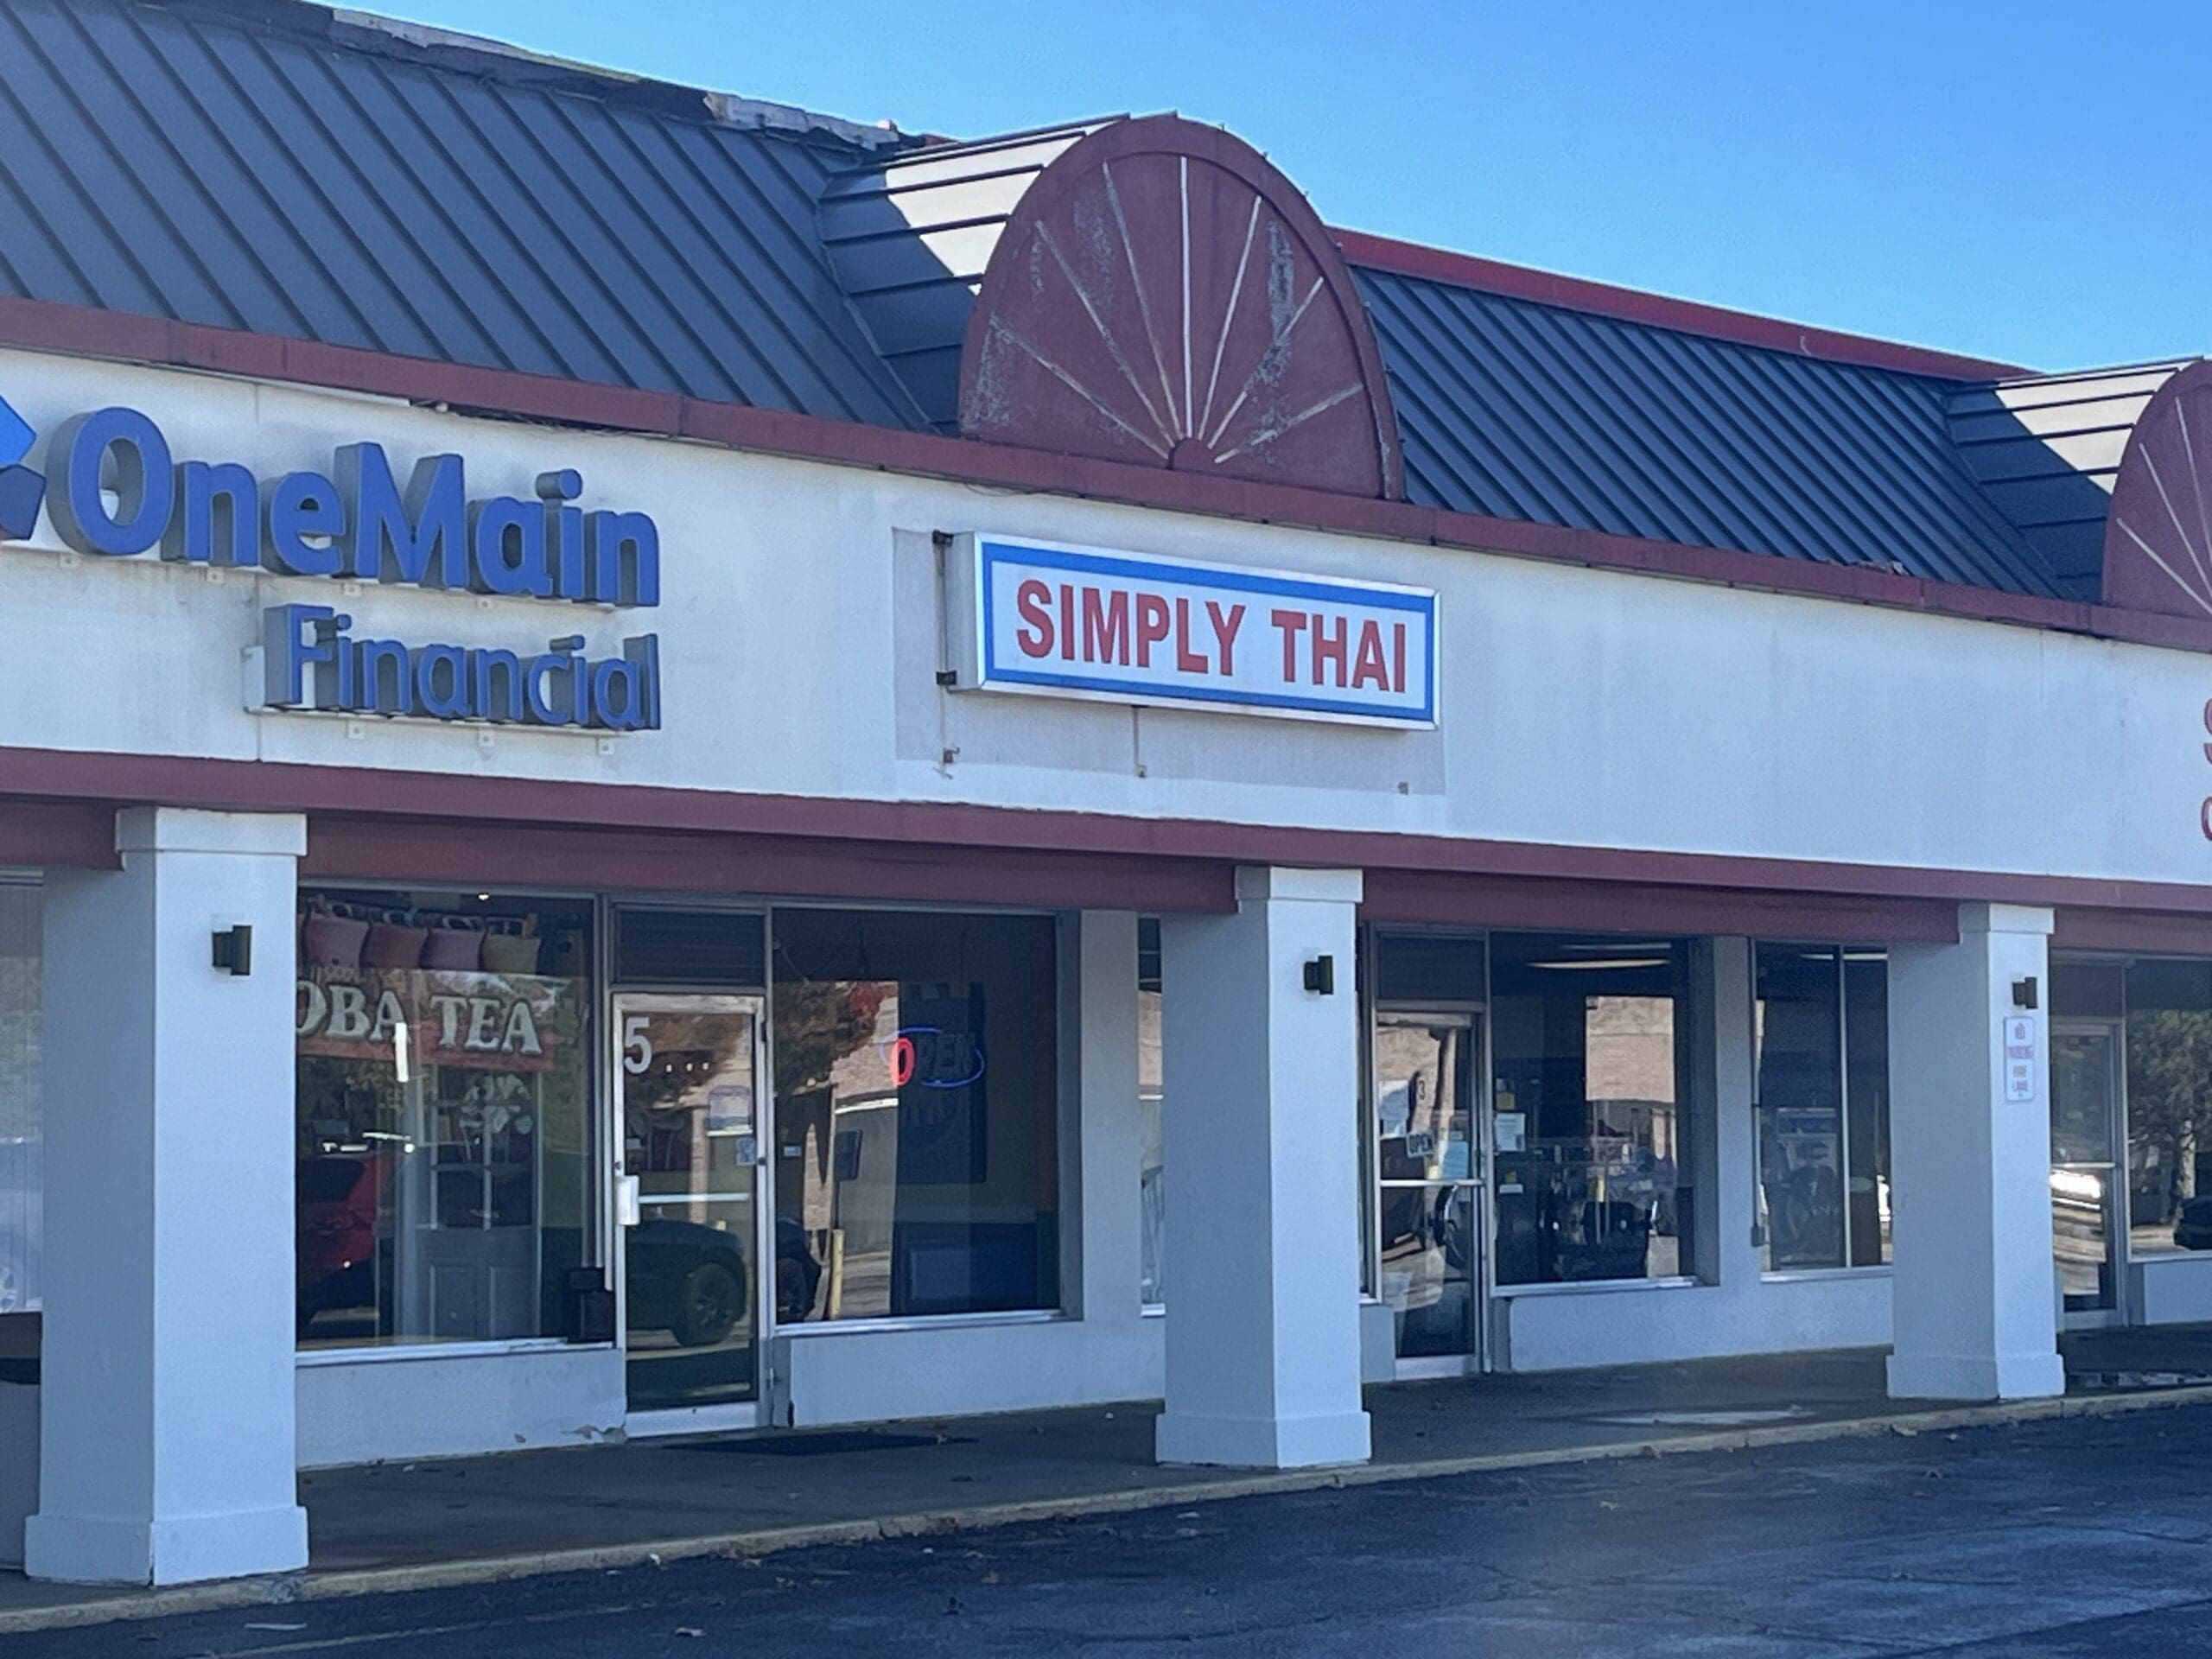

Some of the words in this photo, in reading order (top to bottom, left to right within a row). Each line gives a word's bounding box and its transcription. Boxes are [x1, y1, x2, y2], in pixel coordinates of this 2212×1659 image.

[47, 406, 660, 607] OneMain
[264, 604, 660, 730] Financial
[1016, 579, 1246, 677] SIMPLY
[1271, 608, 1406, 693] THAI
[431, 995, 543, 1055] TEA
[624, 1016, 652, 1074] 5
